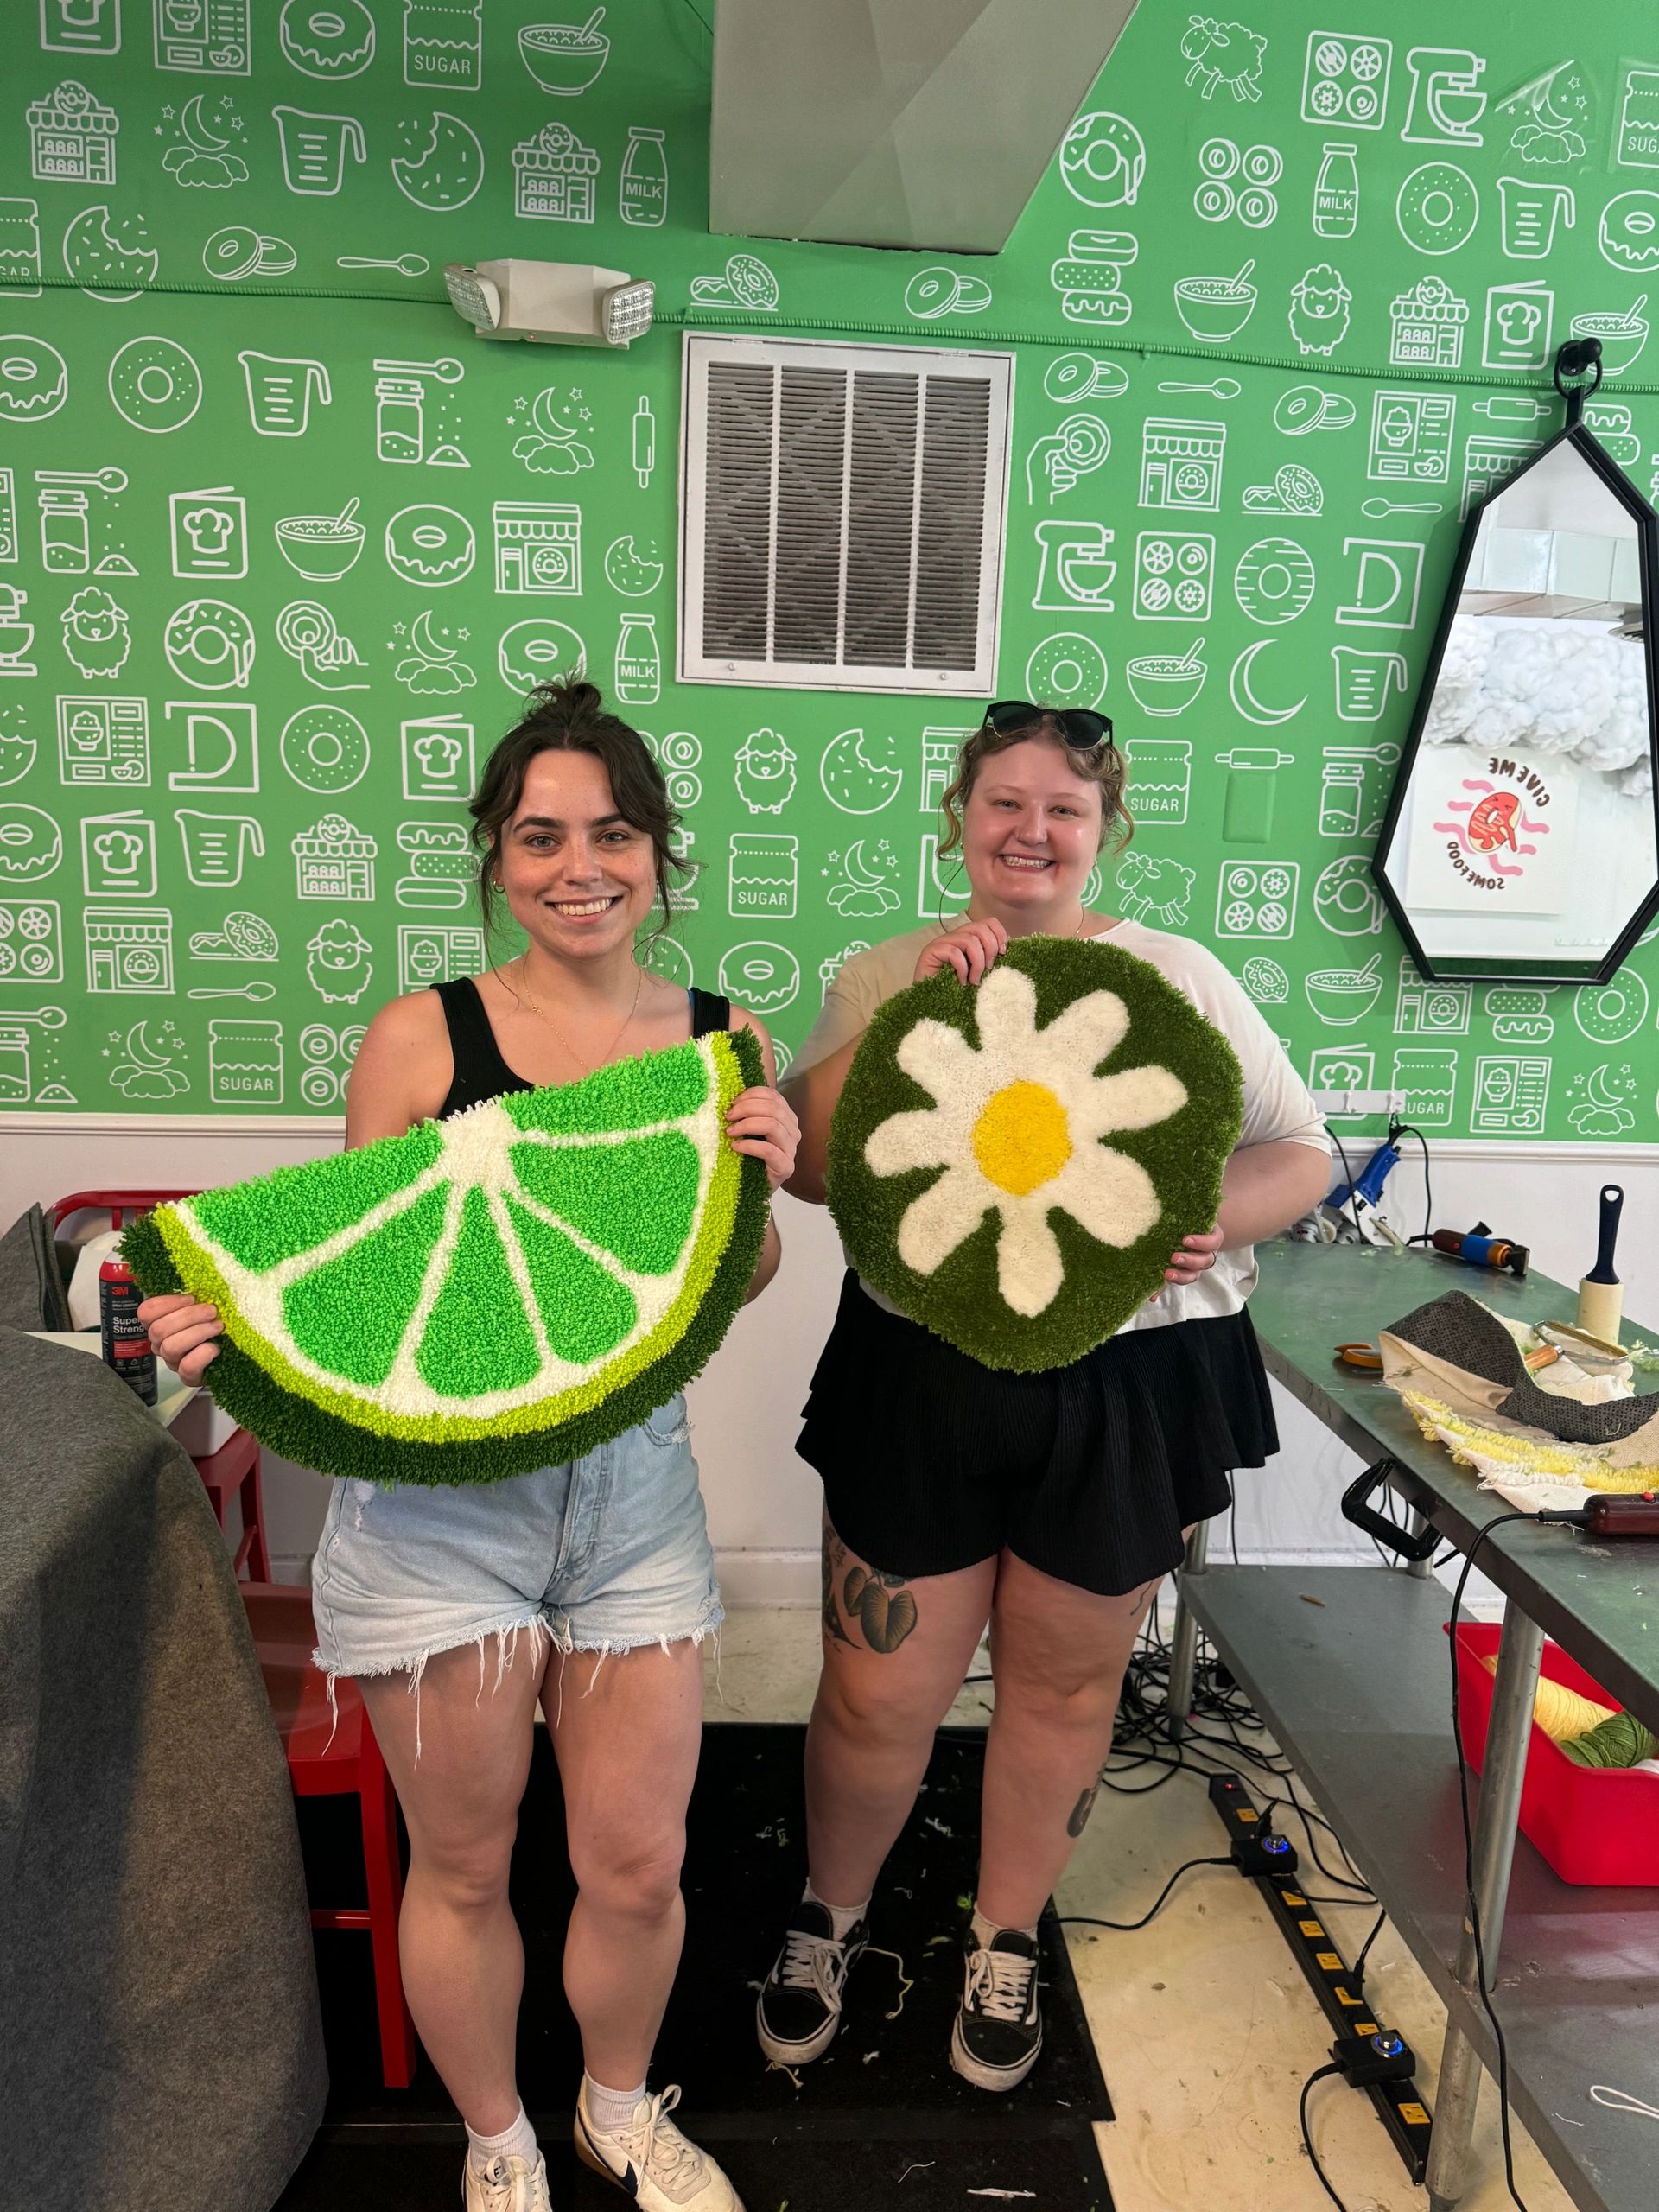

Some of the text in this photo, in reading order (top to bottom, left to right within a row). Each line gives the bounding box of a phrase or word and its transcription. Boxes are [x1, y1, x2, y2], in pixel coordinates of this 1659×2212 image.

[414, 54, 472, 75] SUGAR
[1628, 136, 1659, 154] SUG
[626, 182, 663, 199] MILK
[1319, 196, 1353, 211] MILK
[620, 664, 656, 678] MILK
[1130, 798, 1179, 812] SUGAR
[738, 891, 788, 906] SUGAR
[219, 1077, 274, 1091] SUGAR
[1407, 1102, 1445, 1115] UGAR
[111, 1286, 129, 1296] 3M
[112, 1325, 145, 1334] Streng
